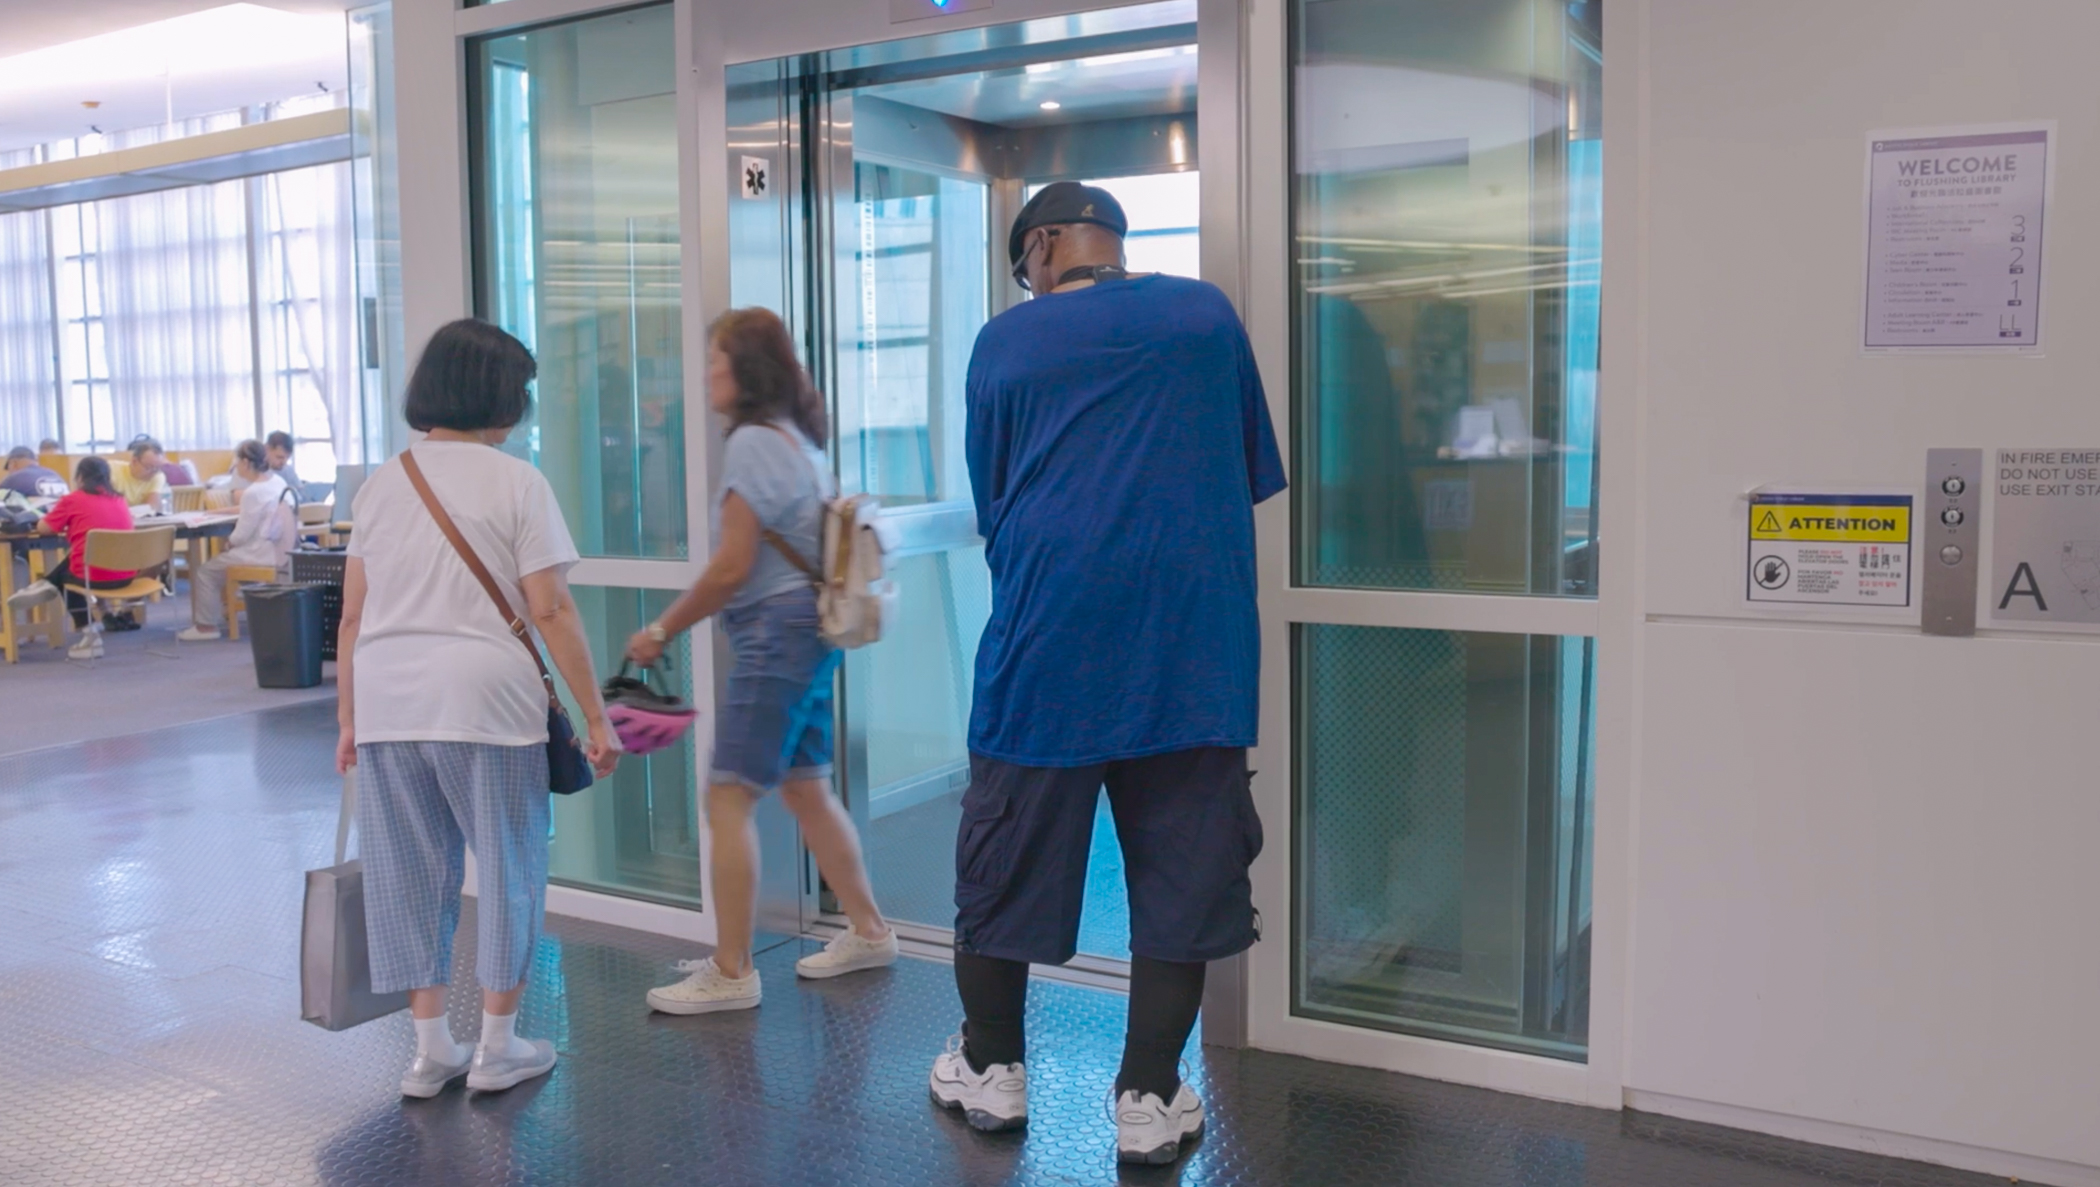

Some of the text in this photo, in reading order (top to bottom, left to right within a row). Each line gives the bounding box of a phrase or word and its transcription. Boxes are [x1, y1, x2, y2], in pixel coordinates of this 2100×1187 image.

[1898, 154, 2017, 176] WELCOME
[1897, 173, 2017, 187] TO FLUSHING LIBRARY
[2011, 214, 2026, 235] 3
[2009, 246, 2024, 267] 2
[2010, 279, 2019, 299] 1
[1999, 313, 2022, 330] LL
[2001, 453, 2016, 464] IN
[2020, 452, 2056, 464] FIRE
[2000, 468, 2097, 480] DO NOT USE
[2000, 484, 2031, 496] USE
[2036, 484, 2071, 496] EXIT
[1789, 517, 1896, 531] ATTENTION
[1998, 562, 2048, 611] A
